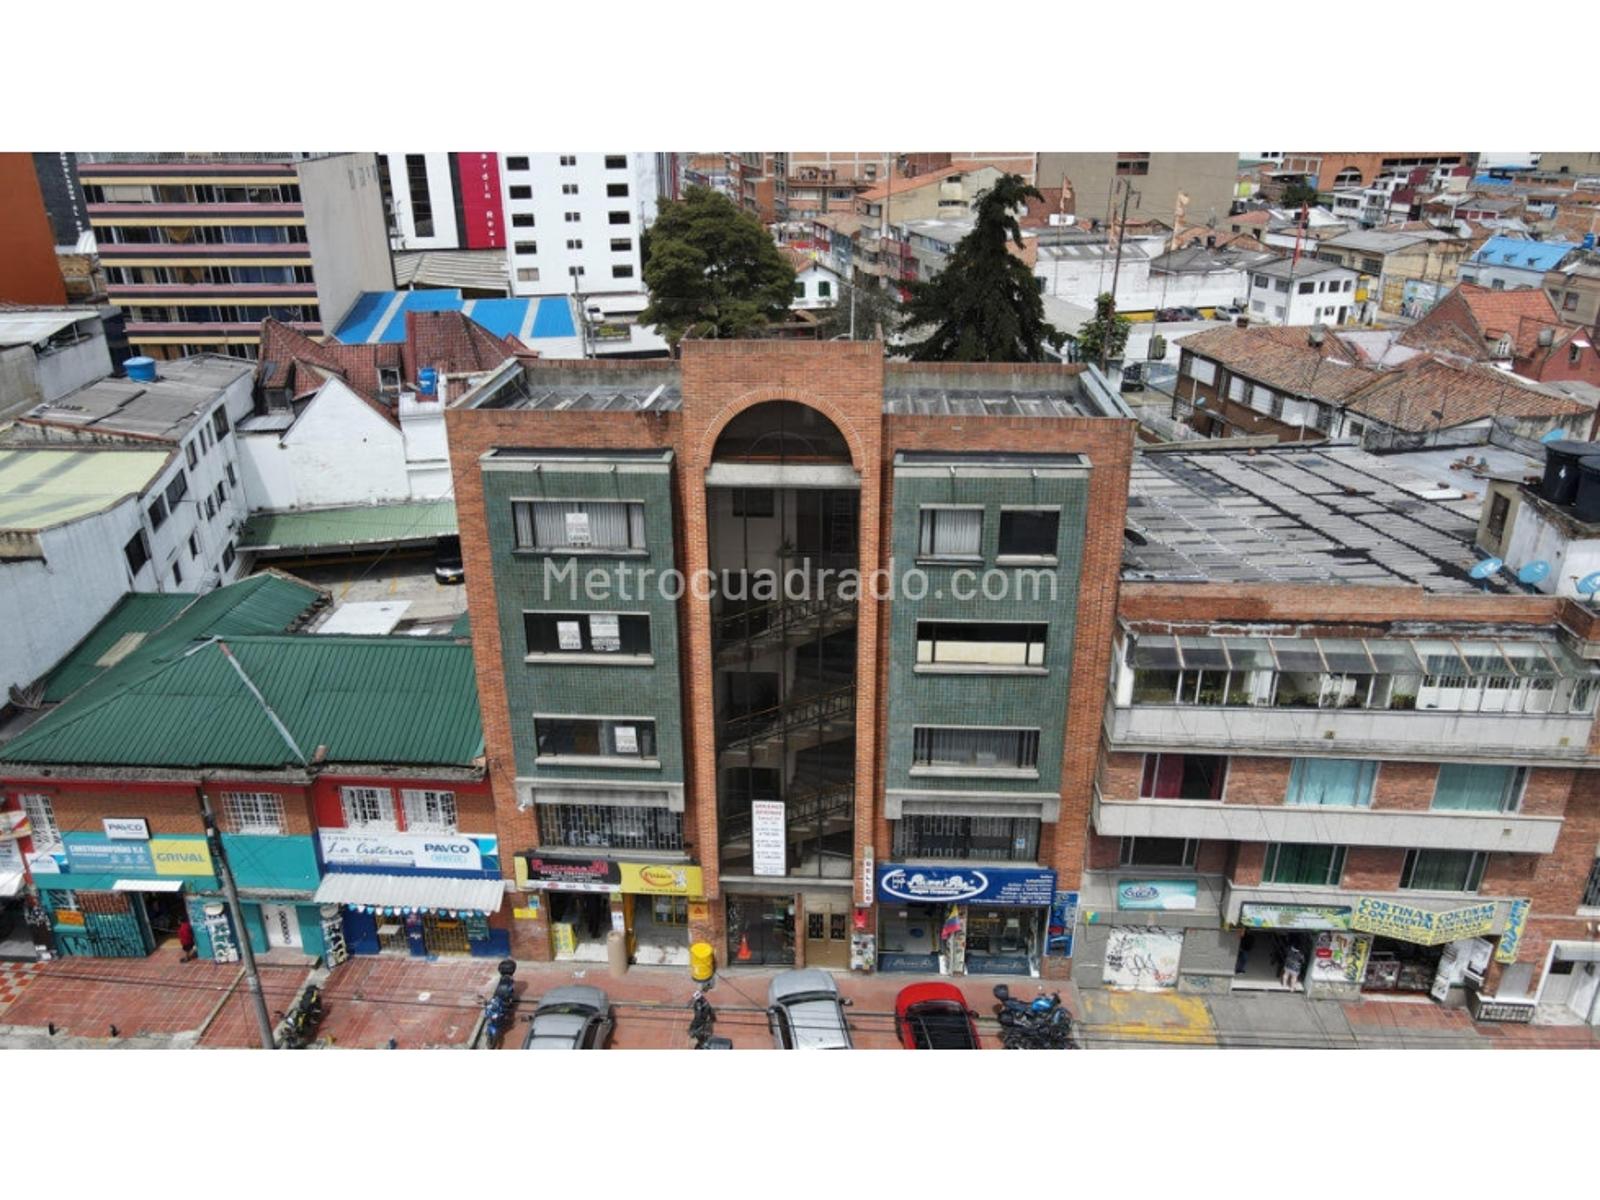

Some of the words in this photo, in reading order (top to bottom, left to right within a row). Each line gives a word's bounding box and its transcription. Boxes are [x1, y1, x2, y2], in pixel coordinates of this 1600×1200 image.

[486, 210, 495, 247] Real
[108, 823, 144, 833] PAVCO
[327, 842, 350, 855] La
[424, 842, 470, 854] PAVCO
[156, 851, 206, 863] GRIVAL
[1360, 898, 1434, 921] CORTINAS
